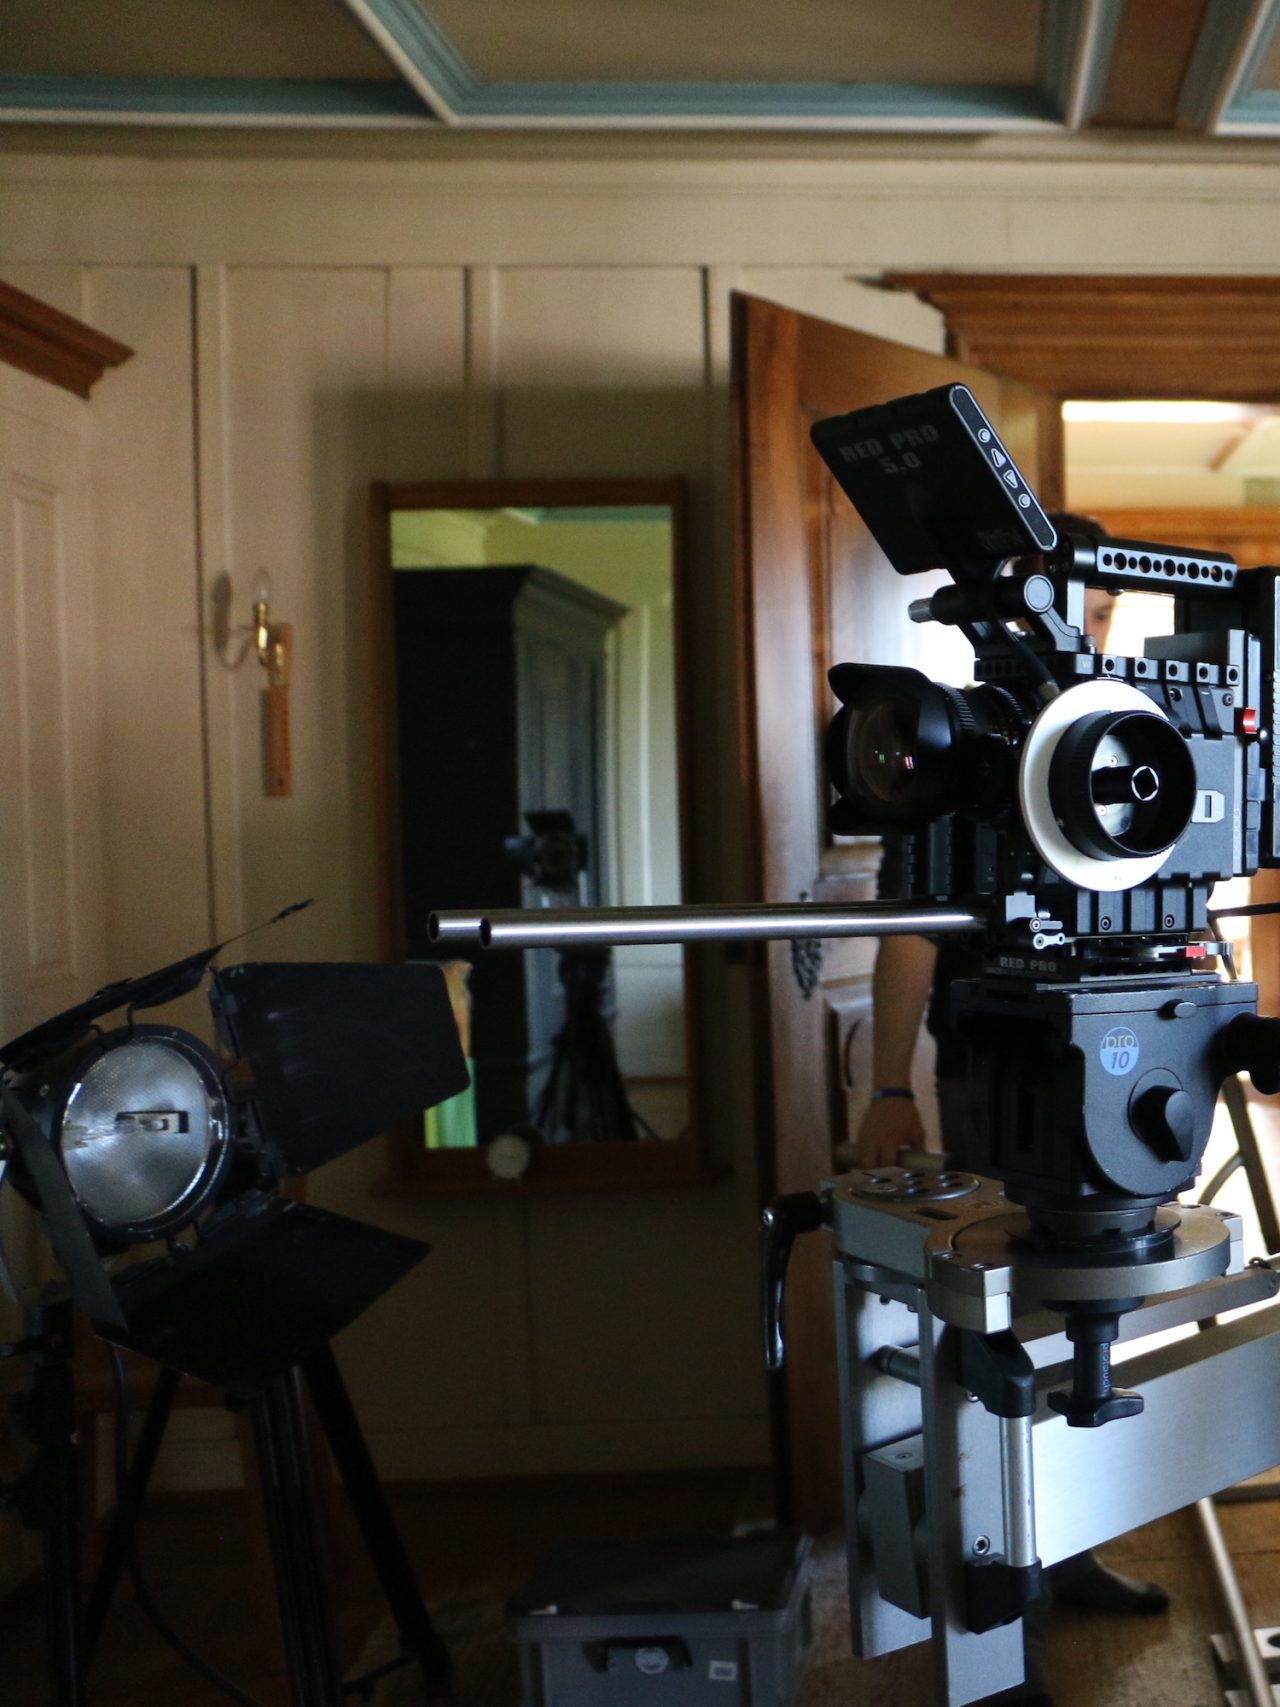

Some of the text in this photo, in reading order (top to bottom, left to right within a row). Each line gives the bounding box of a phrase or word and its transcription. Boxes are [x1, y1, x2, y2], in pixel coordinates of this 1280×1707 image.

[838, 424, 940, 463] RED PRO
[879, 451, 921, 474] 5.0
[1000, 956, 1025, 969] RED
[1029, 959, 1057, 972] PRO
[1105, 1034, 1135, 1049] pro
[1111, 1050, 1131, 1069] 10
